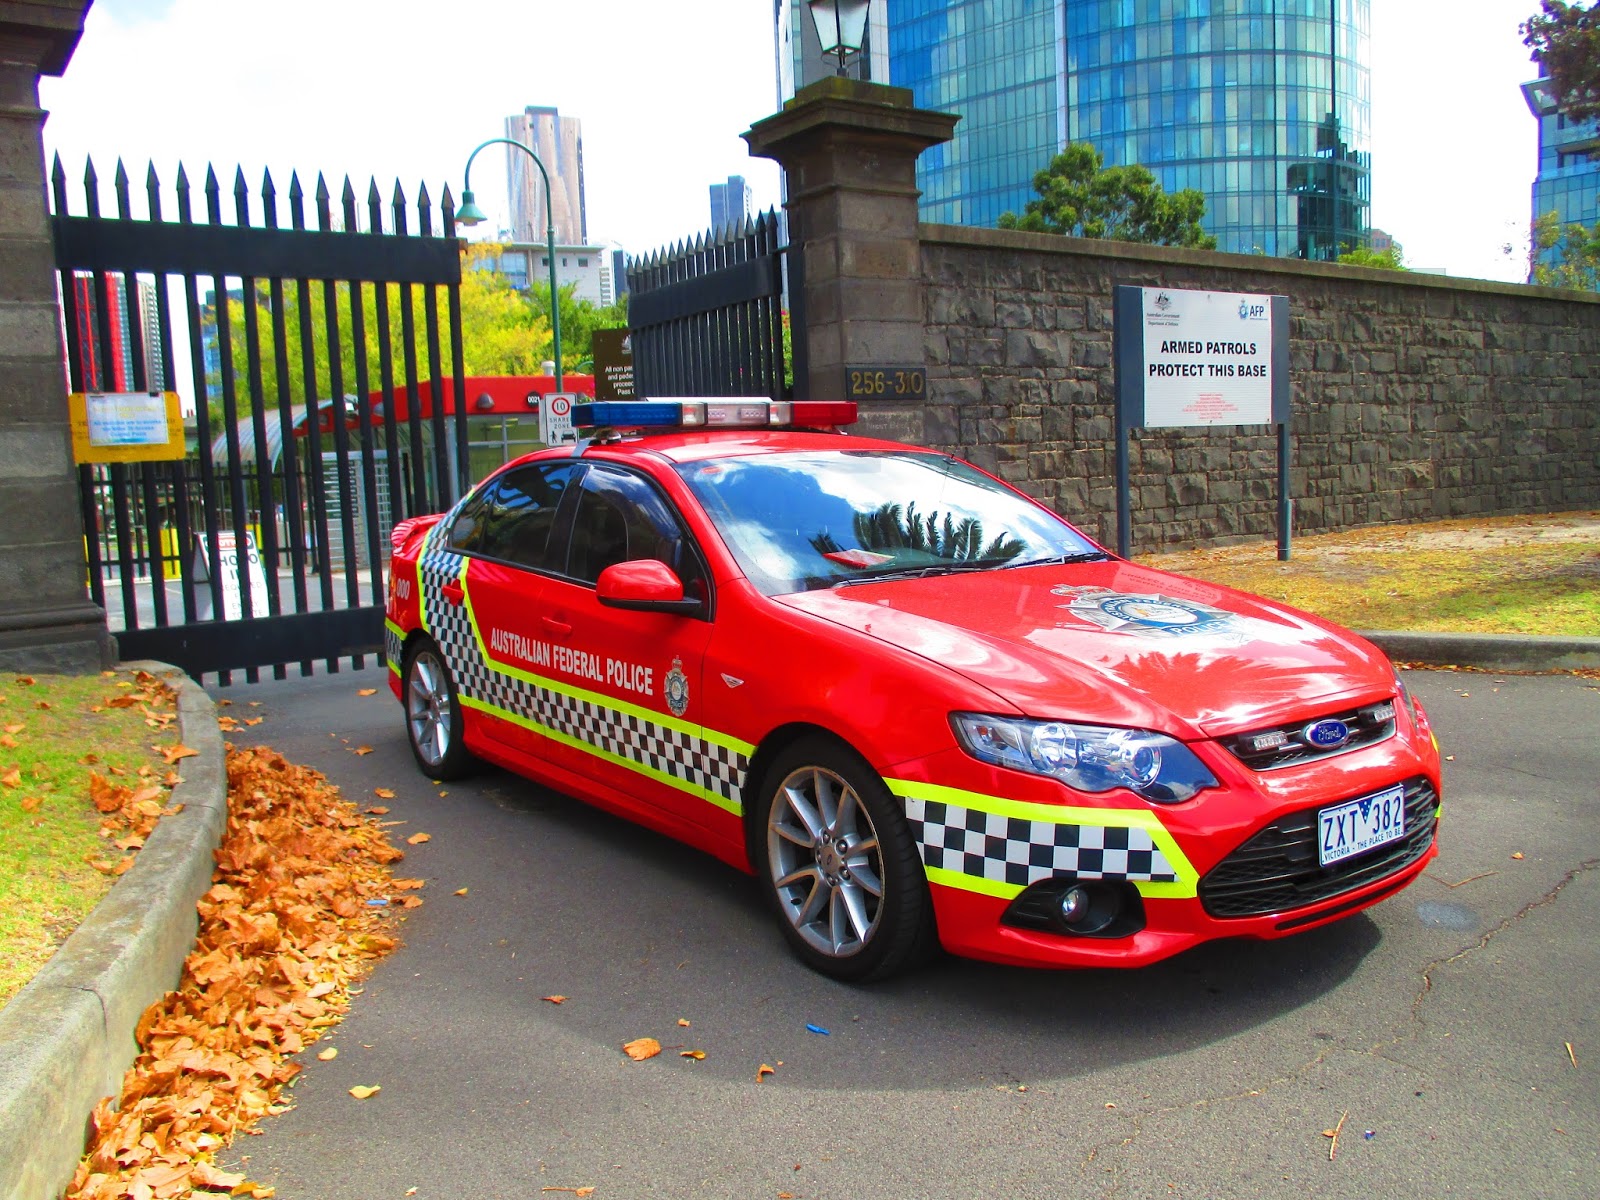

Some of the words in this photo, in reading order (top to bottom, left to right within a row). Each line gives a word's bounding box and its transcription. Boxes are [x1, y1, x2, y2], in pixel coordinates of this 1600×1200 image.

[1249, 305, 1265, 317] AFP
[1160, 340, 1203, 354] ARMED
[1206, 341, 1257, 355] PATROLS
[604, 365, 613, 373] All
[1149, 363, 1205, 377] PROTECT
[1207, 364, 1234, 377] THIS
[1237, 364, 1267, 377] BASE
[607, 373, 618, 381] and
[617, 388, 631, 396] Pass
[556, 402, 566, 411] 10
[1171, 621, 1227, 636] POLICE
[490, 626, 551, 668] AUSTRALIAN
[553, 644, 604, 683] FEDERAL
[606, 657, 654, 696] POLICE
[1317, 725, 1342, 741] Ford
[1323, 809, 1359, 851] ZXT
[1372, 795, 1401, 834] 382
[1324, 846, 1350, 861] VICTORIA
[1357, 837, 1368, 849] THE
[1369, 832, 1385, 845] PLACE
[1385, 830, 1393, 839] TO
